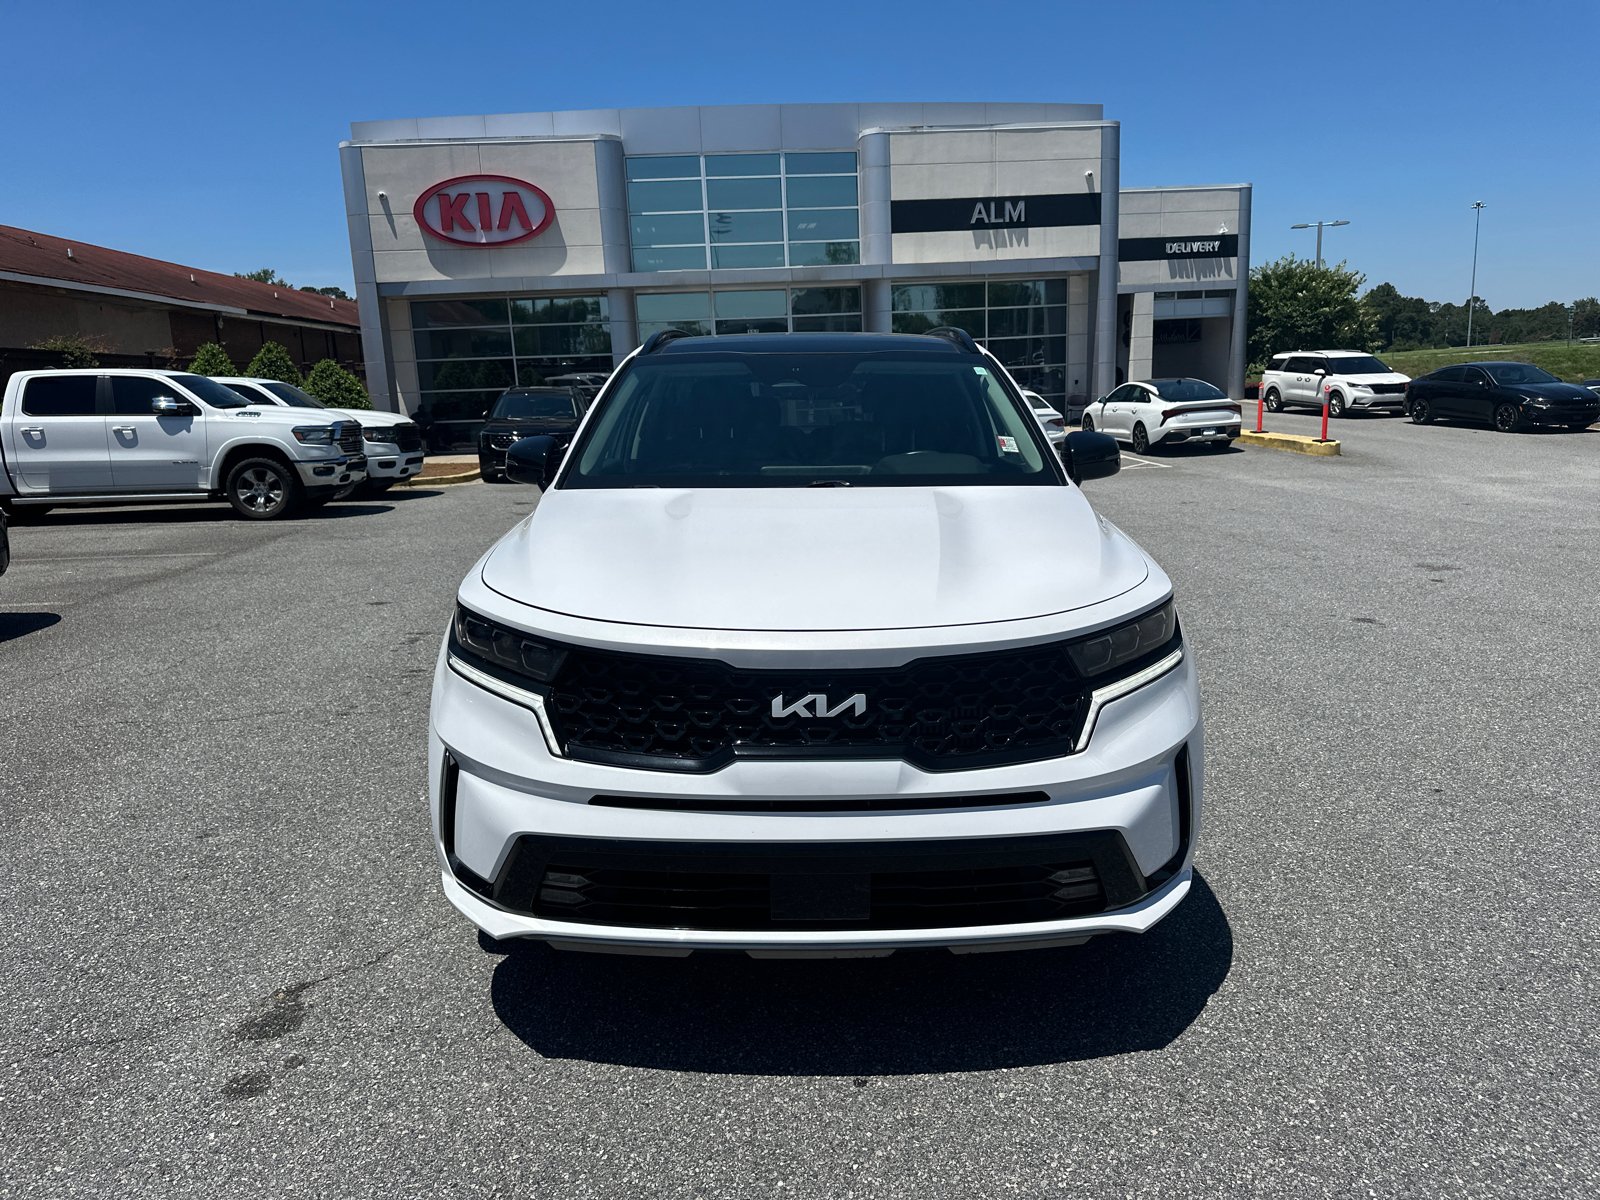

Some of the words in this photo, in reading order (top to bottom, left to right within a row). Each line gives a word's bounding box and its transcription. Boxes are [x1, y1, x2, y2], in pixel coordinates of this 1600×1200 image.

[437, 191, 534, 232] KIA
[970, 200, 1026, 224] ALM
[1165, 240, 1221, 254] DELIVERY
[771, 693, 867, 718] KIA
